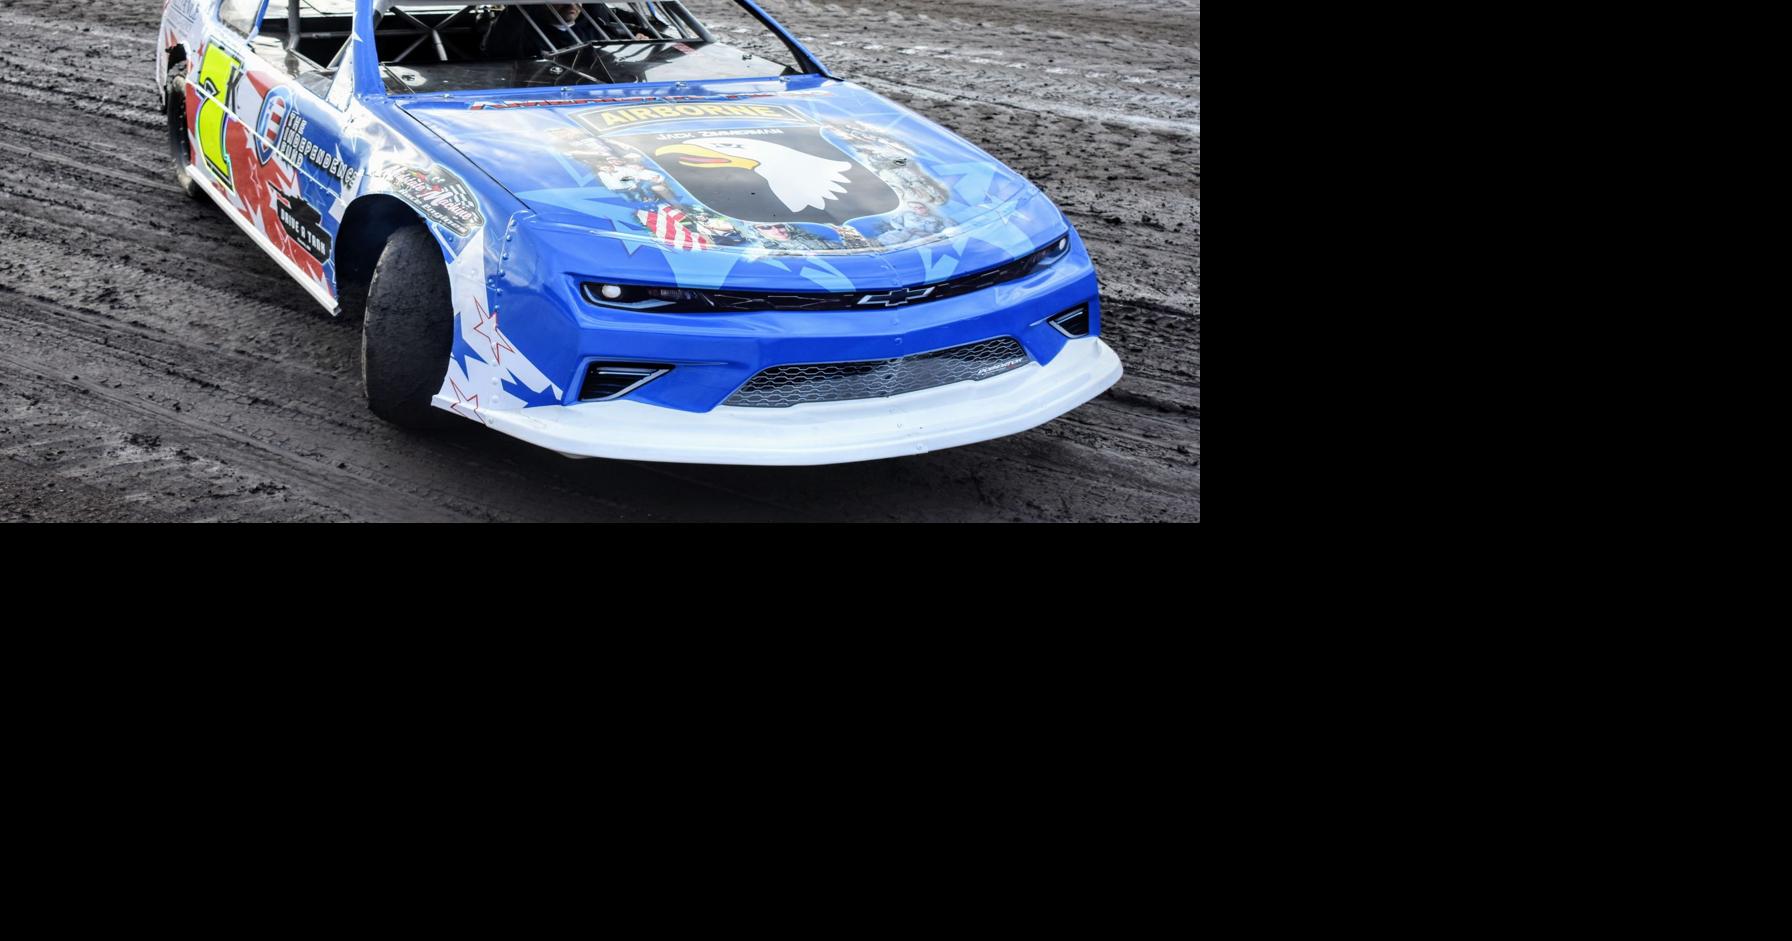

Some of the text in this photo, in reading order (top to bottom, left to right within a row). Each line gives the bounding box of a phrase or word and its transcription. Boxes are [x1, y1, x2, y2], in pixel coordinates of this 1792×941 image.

[288, 111, 307, 135] THE
[601, 104, 781, 126] AIRBORNE
[657, 133, 694, 141] JACK
[279, 141, 304, 168] FUND
[283, 126, 361, 188] INDEPENDENCE
[280, 208, 300, 233] DRIVE
[307, 230, 326, 255] TANK
